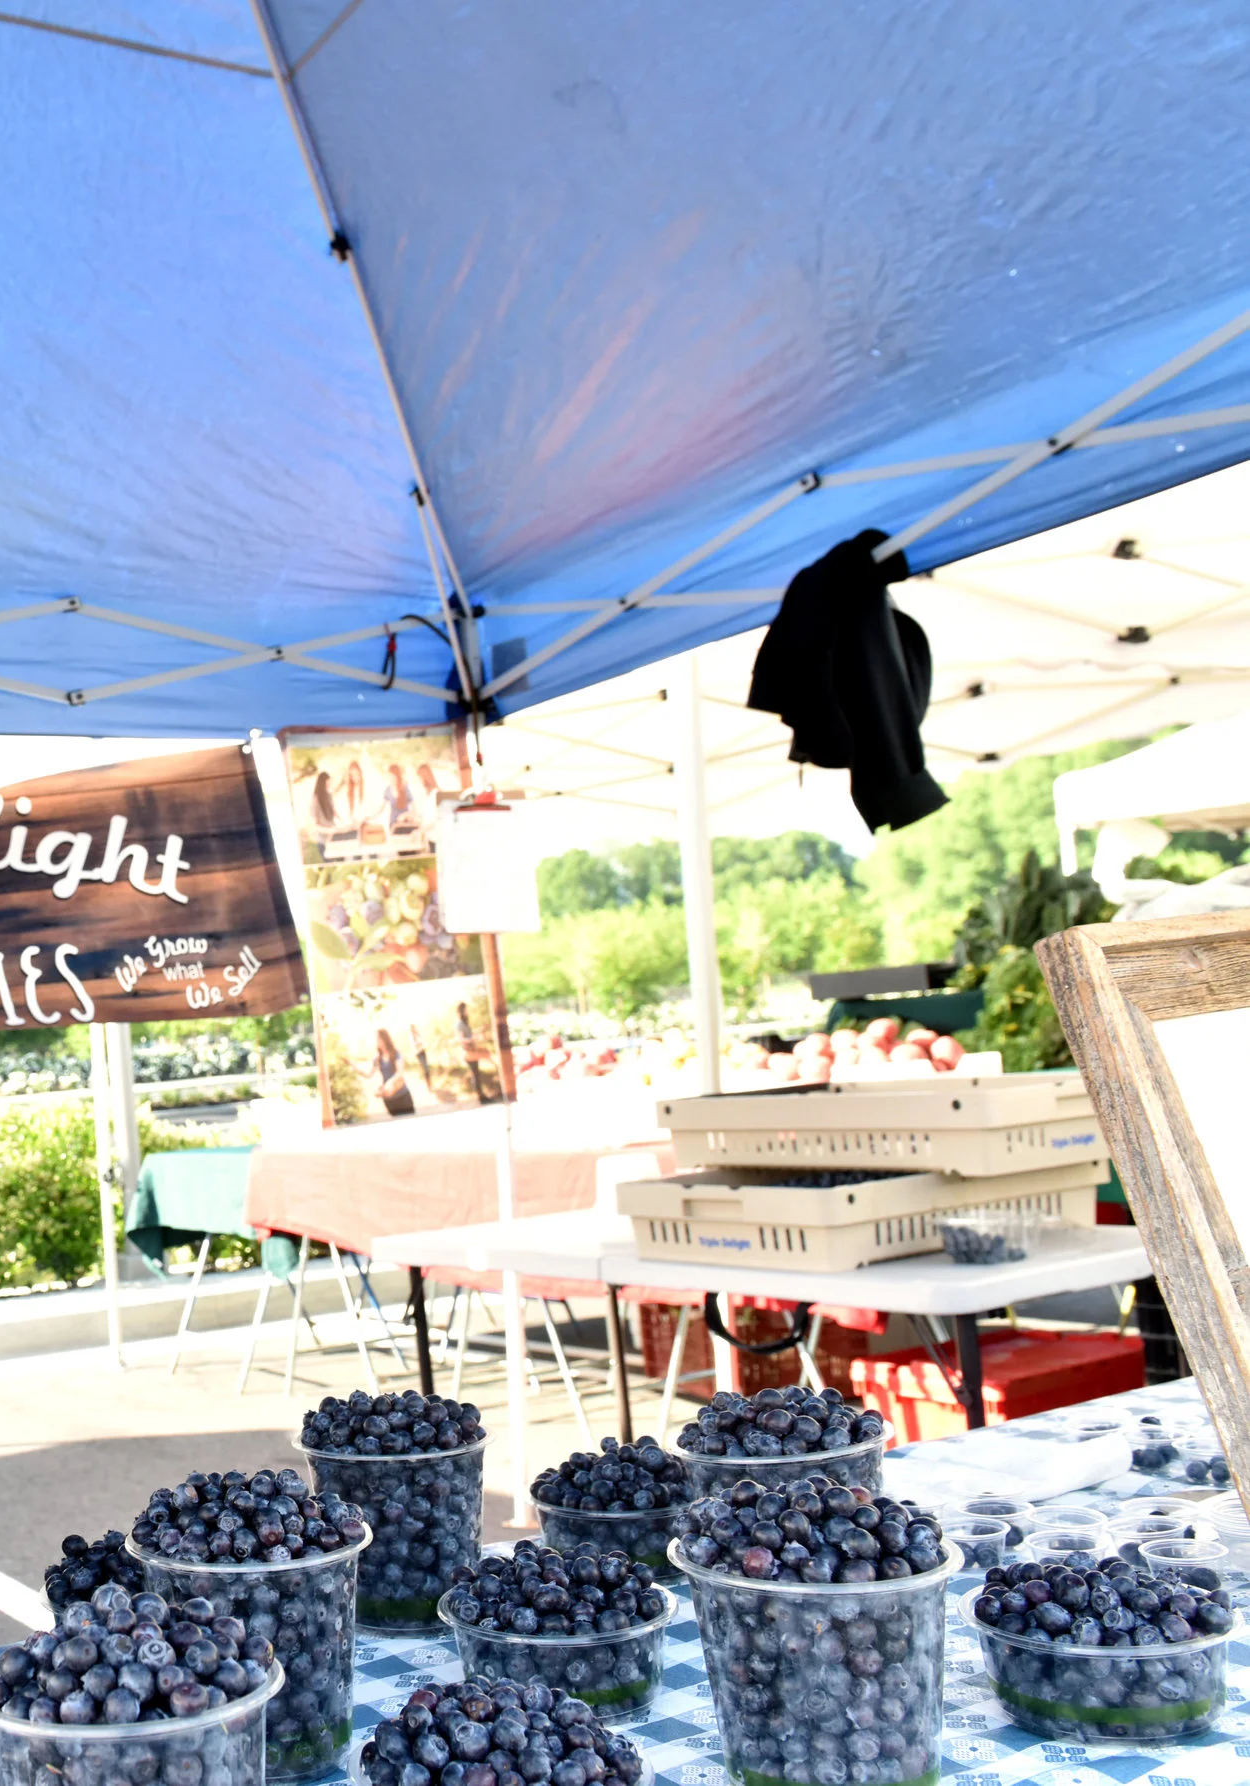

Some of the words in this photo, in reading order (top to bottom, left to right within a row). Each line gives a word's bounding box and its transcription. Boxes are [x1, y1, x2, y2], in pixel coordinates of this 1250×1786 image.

[114, 954, 147, 992] We
[144, 935, 208, 968] Grow
[162, 961, 206, 982] what
[185, 981, 224, 1009] We
[223, 945, 263, 997] Sell
